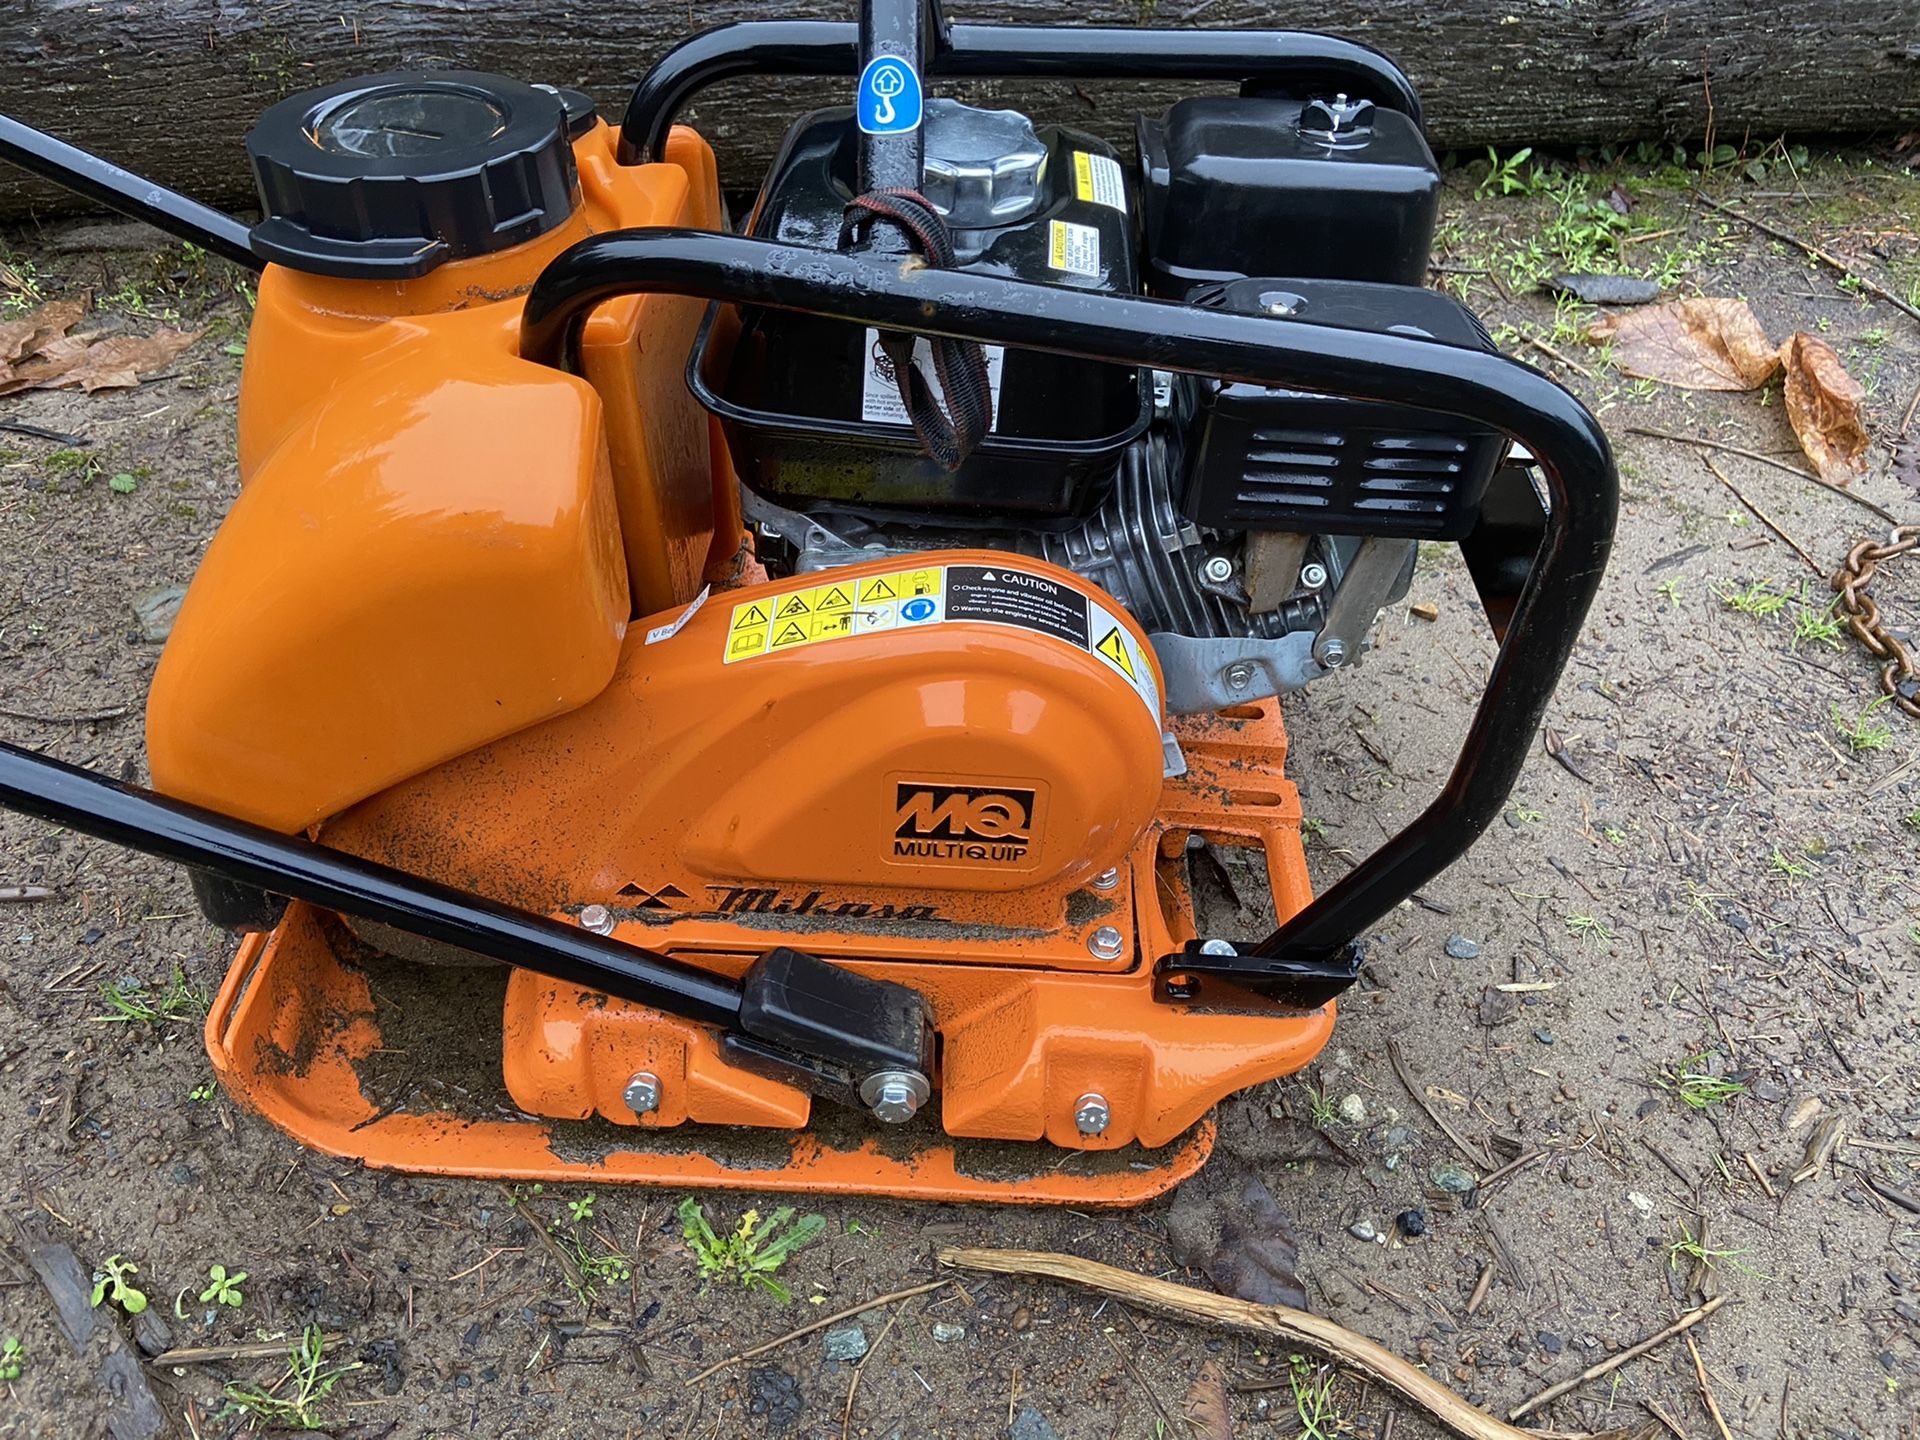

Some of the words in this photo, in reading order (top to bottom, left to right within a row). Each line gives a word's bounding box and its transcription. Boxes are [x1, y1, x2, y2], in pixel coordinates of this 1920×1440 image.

[1056, 229, 1064, 253] CAUTION
[1002, 573, 1058, 595] CAUTION
[1020, 592, 1044, 602] vibrator
[1054, 601, 1072, 613] before
[1005, 610, 1028, 619] engine
[1039, 618, 1060, 629] several
[895, 791, 1030, 839] MQ
[894, 841, 1028, 861] MULTIQUIP
[704, 884, 952, 922] Mikasa
